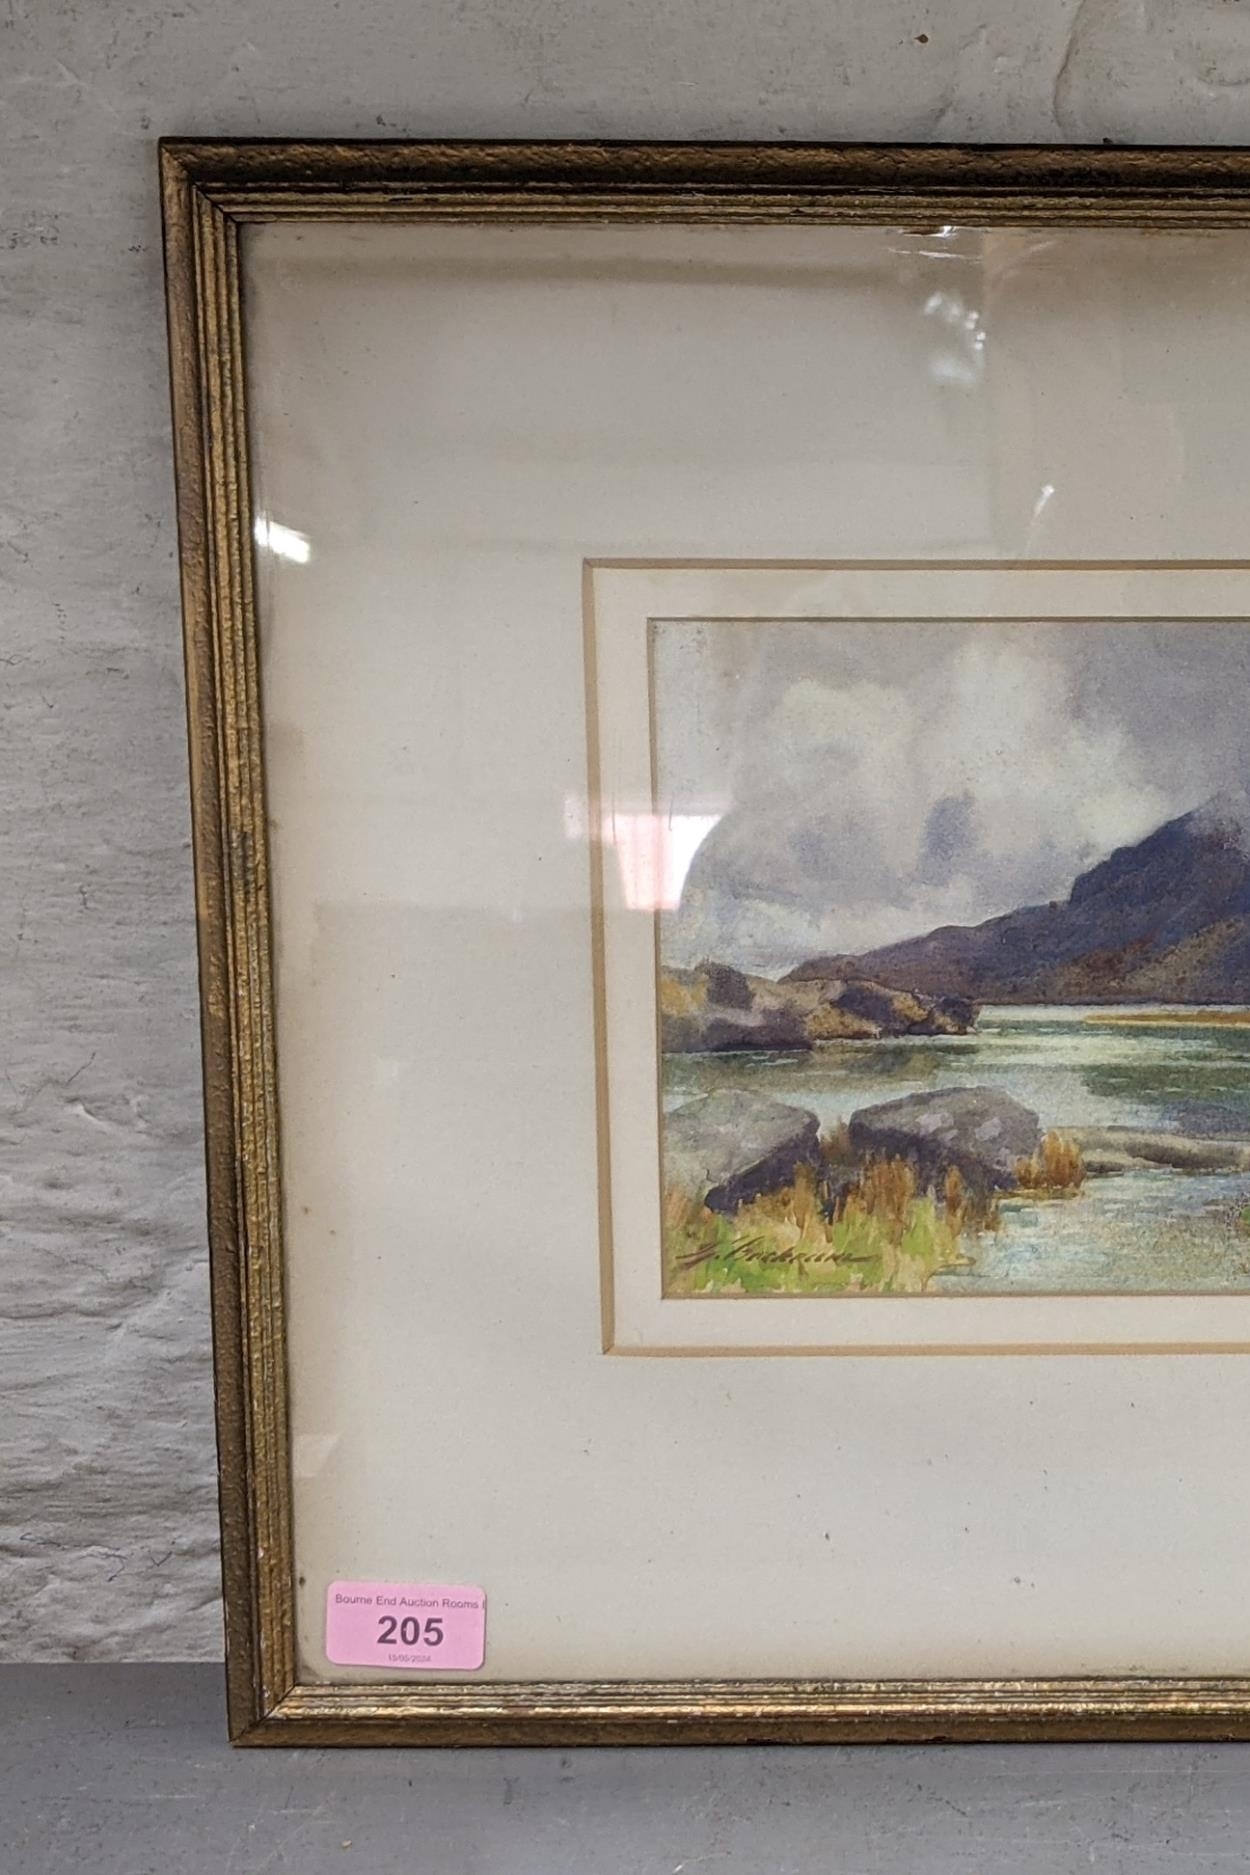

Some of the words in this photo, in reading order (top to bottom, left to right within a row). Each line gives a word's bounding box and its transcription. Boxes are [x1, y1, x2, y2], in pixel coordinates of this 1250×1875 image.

[335, 1594, 373, 1605] Bourne
[376, 1595, 397, 1606] End
[399, 1596, 439, 1608] Auction
[442, 1598, 479, 1609] Rooms
[377, 1616, 444, 1647] 205
